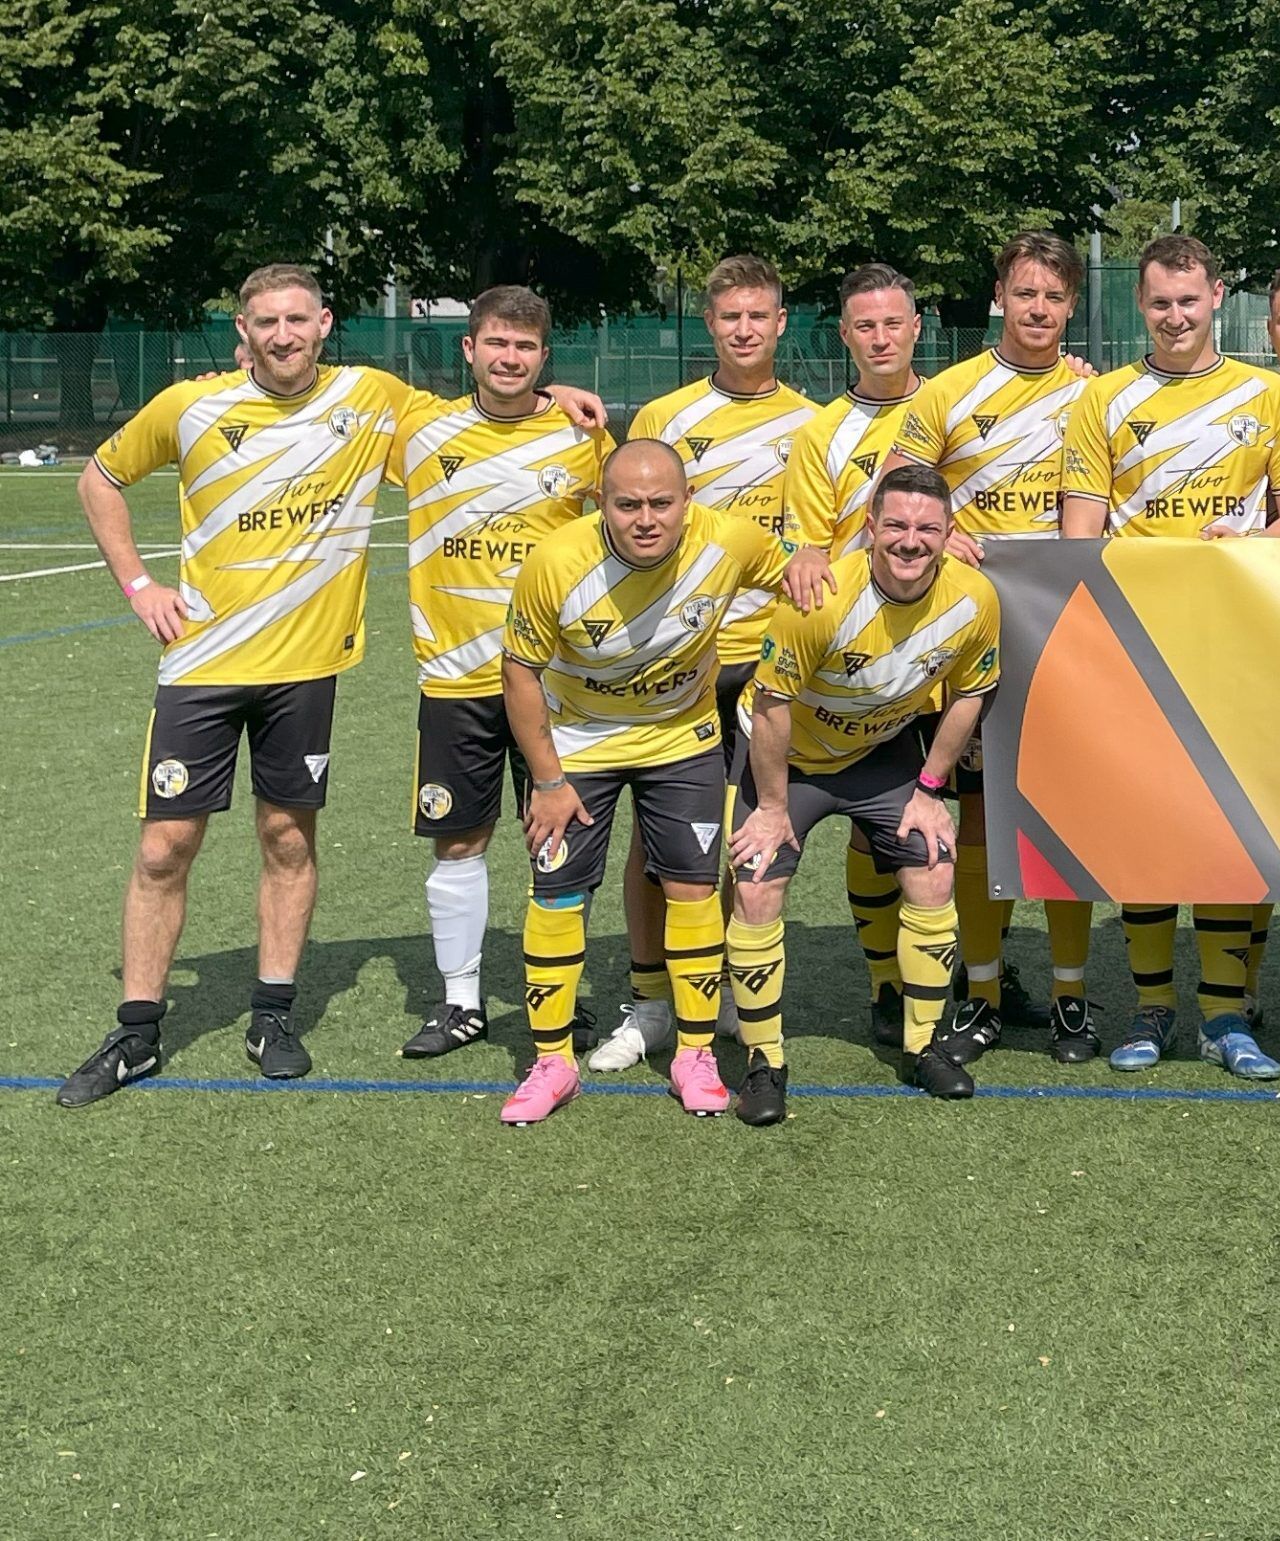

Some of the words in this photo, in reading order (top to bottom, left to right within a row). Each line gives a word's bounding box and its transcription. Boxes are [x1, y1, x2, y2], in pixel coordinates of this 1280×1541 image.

[997, 459, 1061, 487] Two
[1165, 464, 1230, 494] Two
[263, 470, 332, 505] Two
[713, 484, 779, 511] Two
[1145, 495, 1245, 520] BREWERS
[465, 510, 532, 536] Two
[774, 665, 801, 680] group
